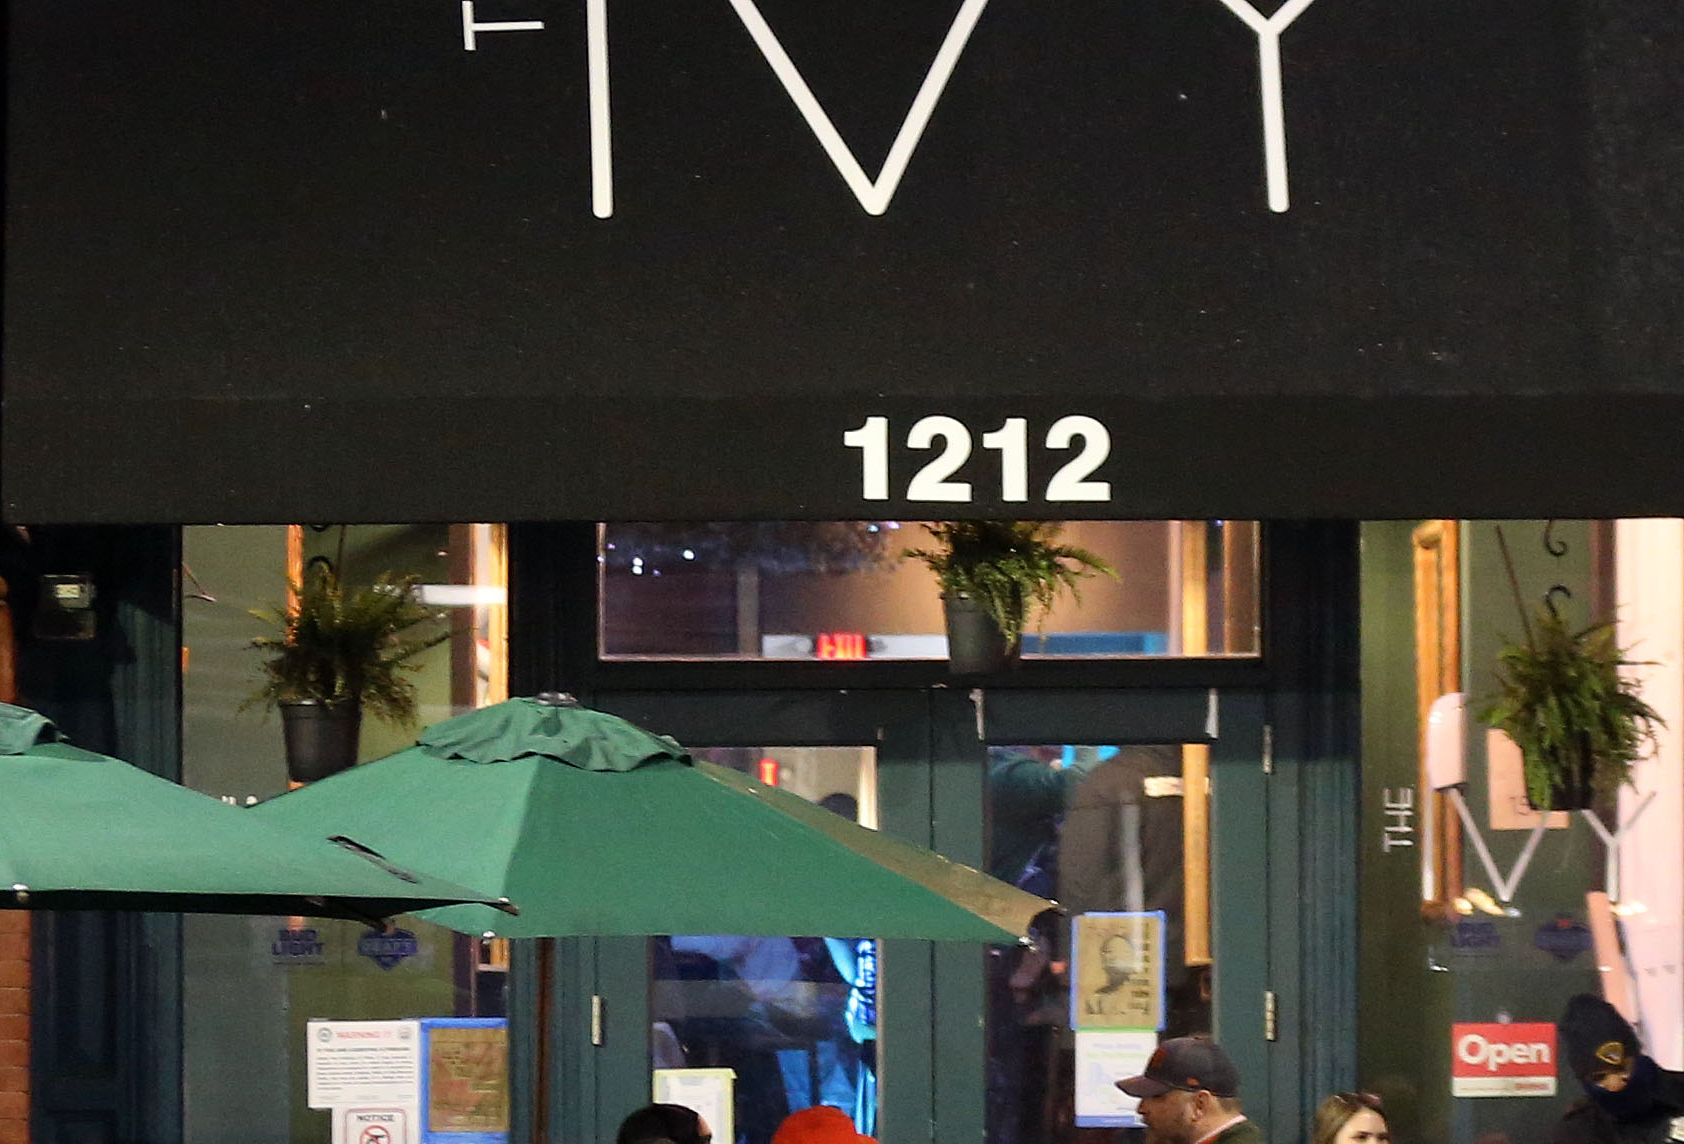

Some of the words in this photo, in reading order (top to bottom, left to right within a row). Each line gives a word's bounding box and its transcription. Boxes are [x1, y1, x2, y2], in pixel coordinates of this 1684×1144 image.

[843, 415, 1112, 503] 1212
[1383, 787, 1414, 853] THE
[1457, 1034, 1552, 1072] Open
[356, 1114, 395, 1122] NOTICE
